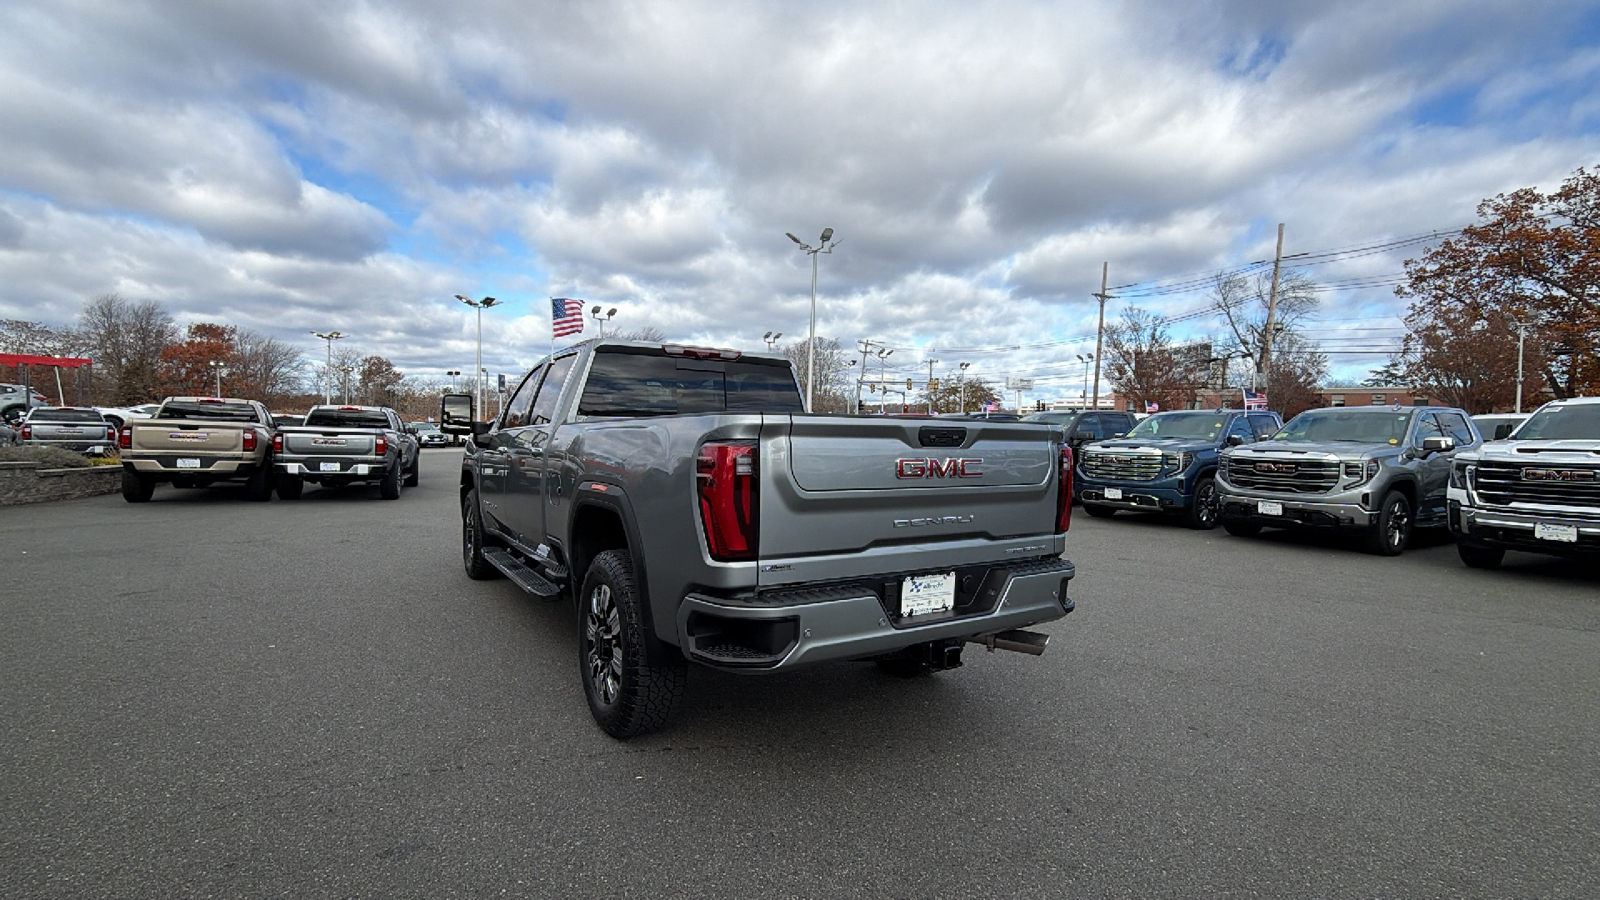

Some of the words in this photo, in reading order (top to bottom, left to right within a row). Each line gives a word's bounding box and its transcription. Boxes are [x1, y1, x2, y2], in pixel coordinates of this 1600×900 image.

[895, 457, 984, 479] GMC
[1254, 462, 1296, 472] GMC
[1525, 469, 1594, 481] GMC
[893, 514, 974, 528] DENALI
